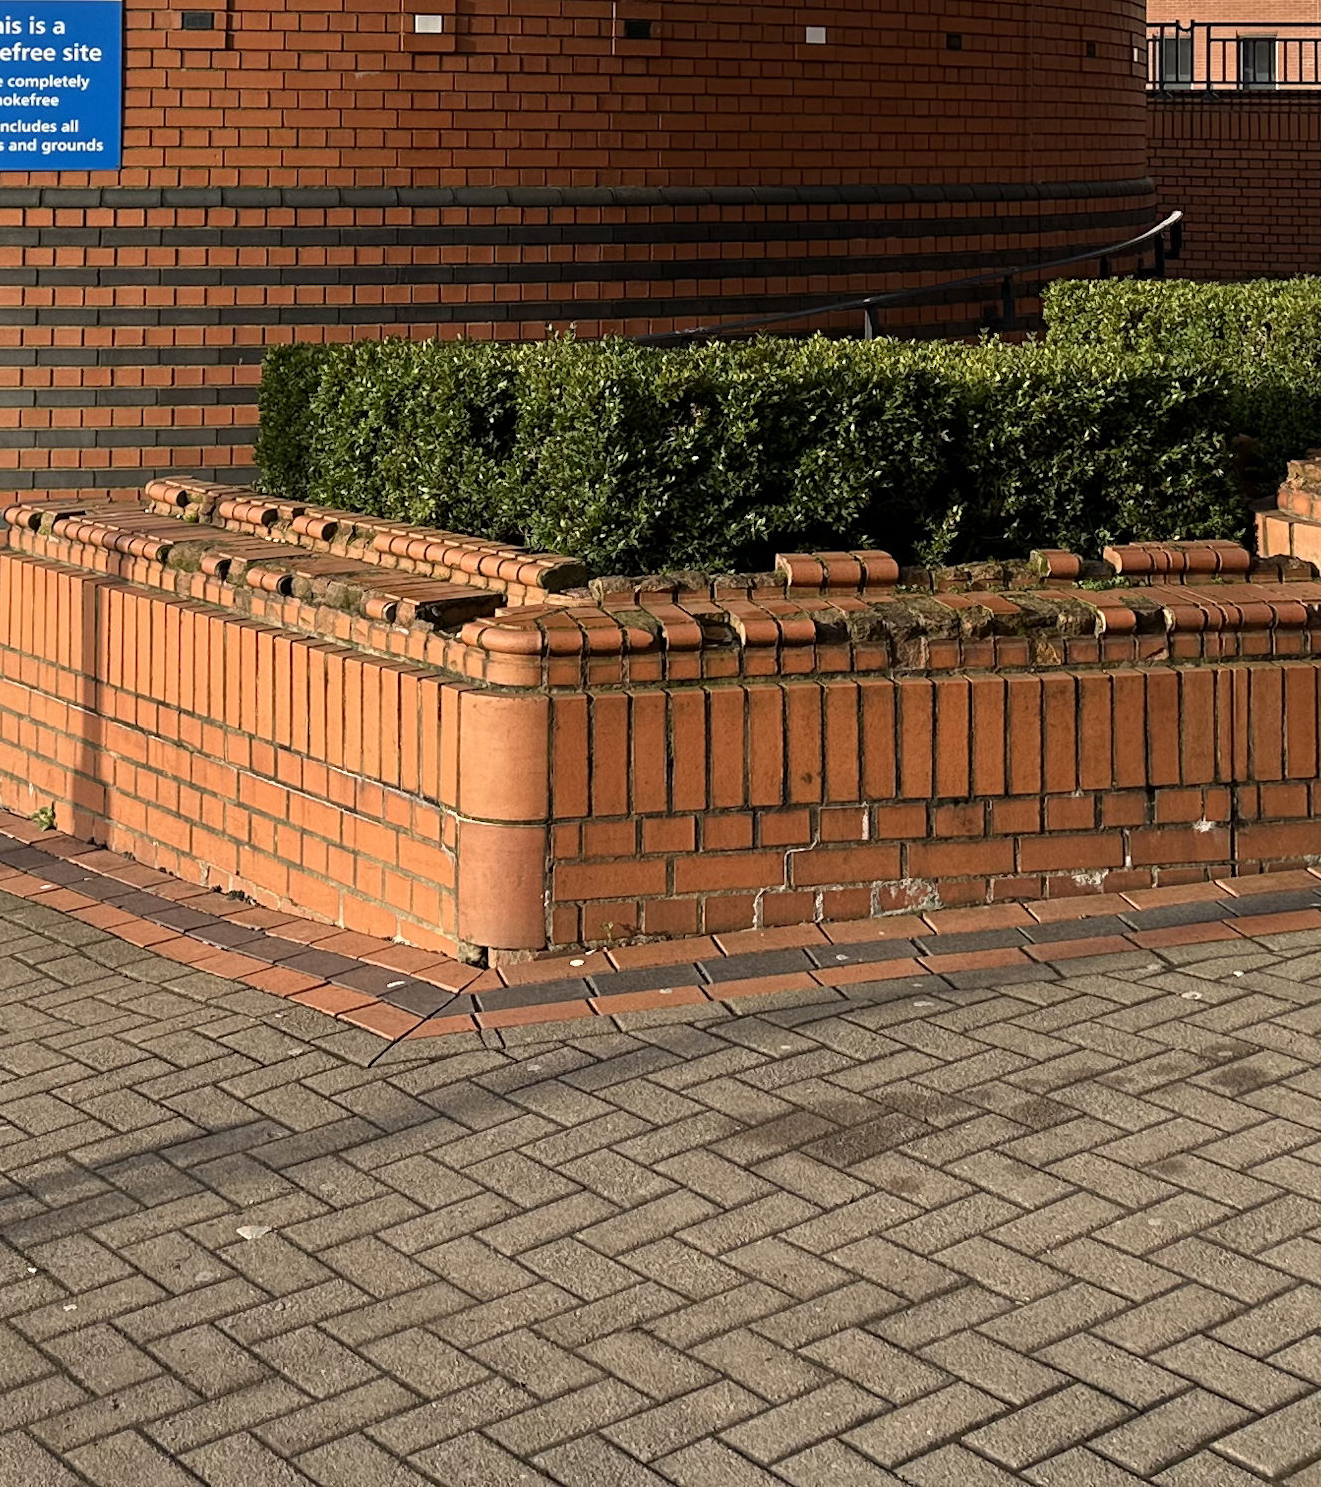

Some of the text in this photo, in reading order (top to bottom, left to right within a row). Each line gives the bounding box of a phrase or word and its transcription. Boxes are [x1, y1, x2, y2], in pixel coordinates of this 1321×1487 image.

[29, 15, 46, 35] is
[52, 20, 66, 35] a
[62, 43, 102, 62] site
[7, 74, 90, 91] completely
[61, 119, 79, 133] all
[8, 138, 37, 152] and
[41, 138, 104, 155] grounds
